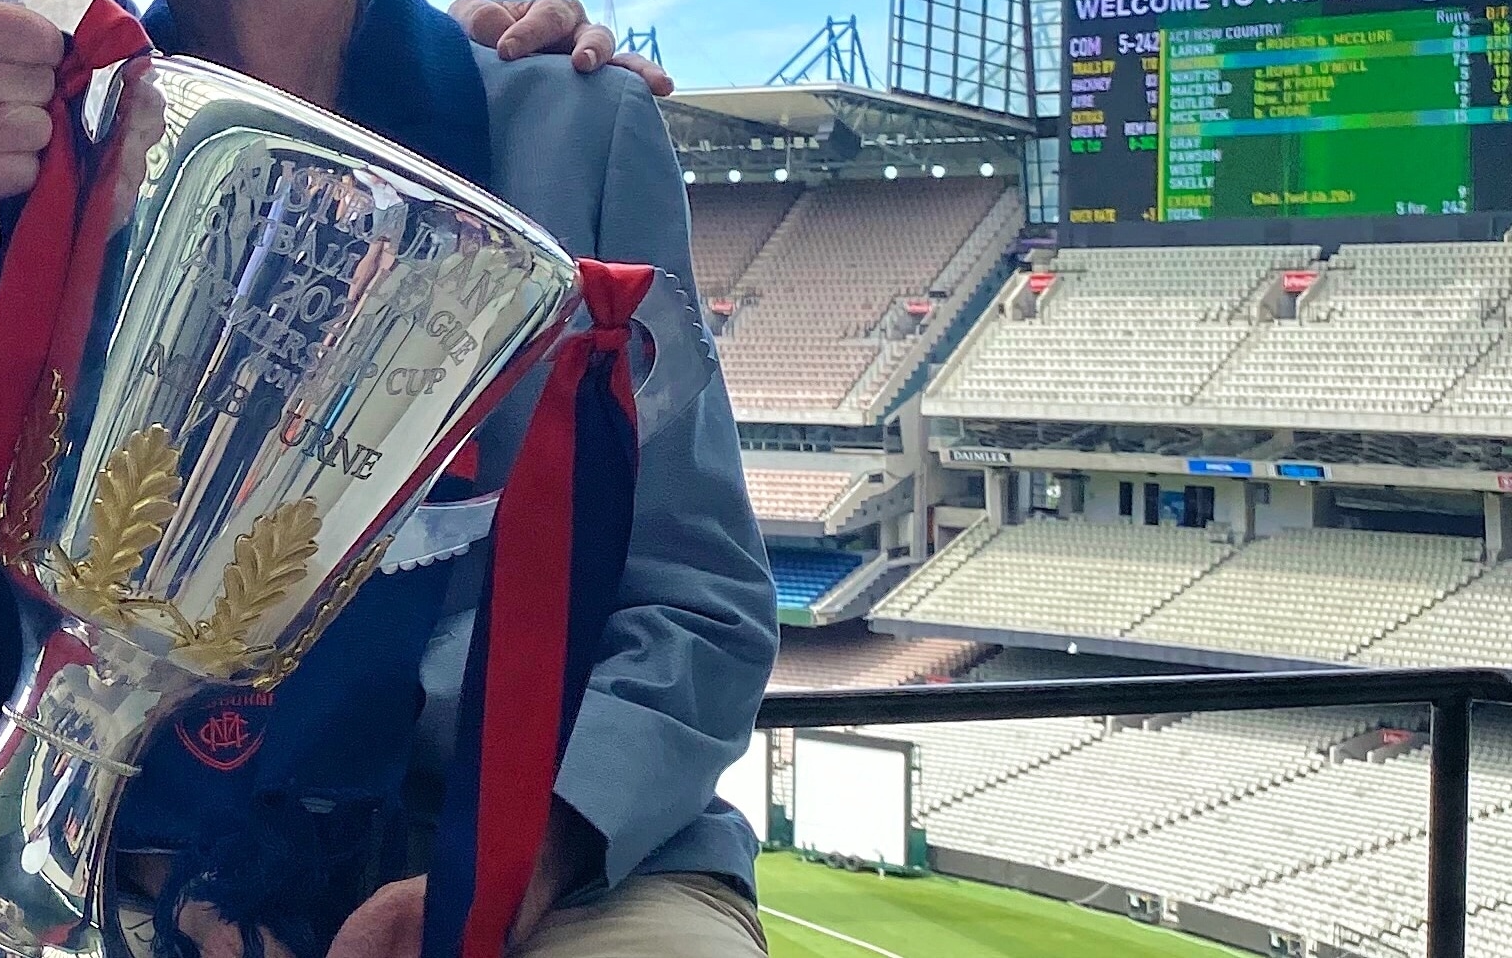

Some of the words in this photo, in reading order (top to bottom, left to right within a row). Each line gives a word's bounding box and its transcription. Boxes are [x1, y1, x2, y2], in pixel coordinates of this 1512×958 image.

[1225, 23, 1281, 40] COUNTRY
[1070, 35, 1102, 58] COM
[386, 366, 447, 398] CUP
